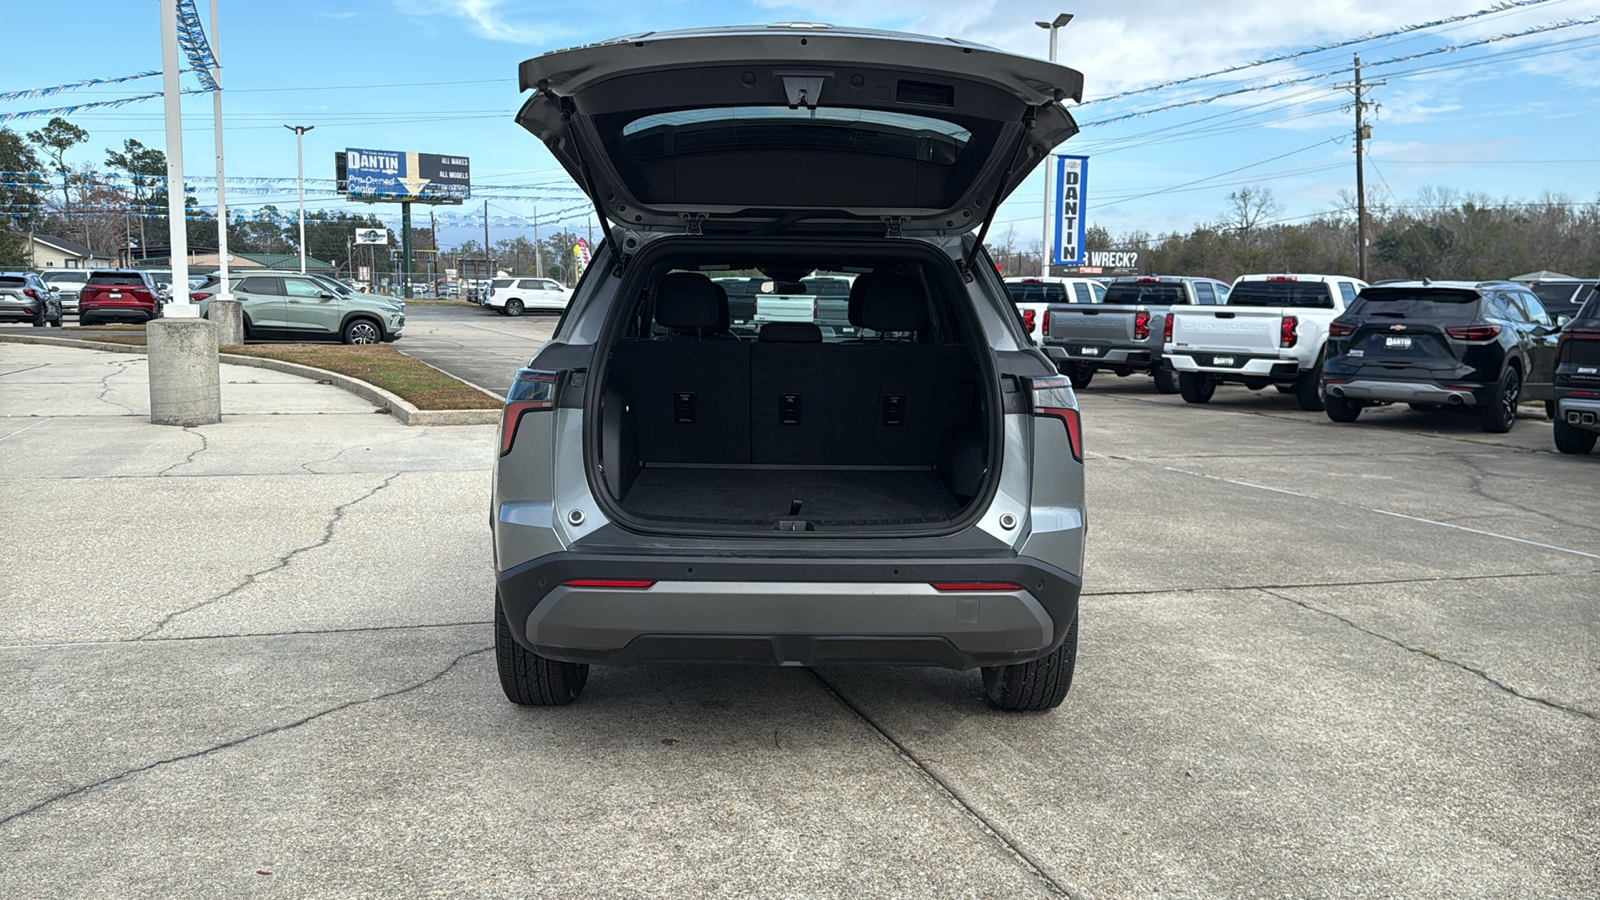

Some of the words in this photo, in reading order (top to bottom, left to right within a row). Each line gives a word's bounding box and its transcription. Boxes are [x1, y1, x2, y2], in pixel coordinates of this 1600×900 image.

[348, 151, 398, 169] DANTIN
[441, 157, 450, 165] ALL
[451, 158, 468, 166] MAKES
[349, 175, 395, 185] Pre-Owned
[439, 170, 448, 178] ALL
[449, 171, 469, 180] MODELS
[349, 184, 376, 194] Center
[1063, 171, 1079, 260] DANTIN
[1091, 251, 1138, 268] WRECK?
[1182, 322, 1268, 332] CHEVROLET
